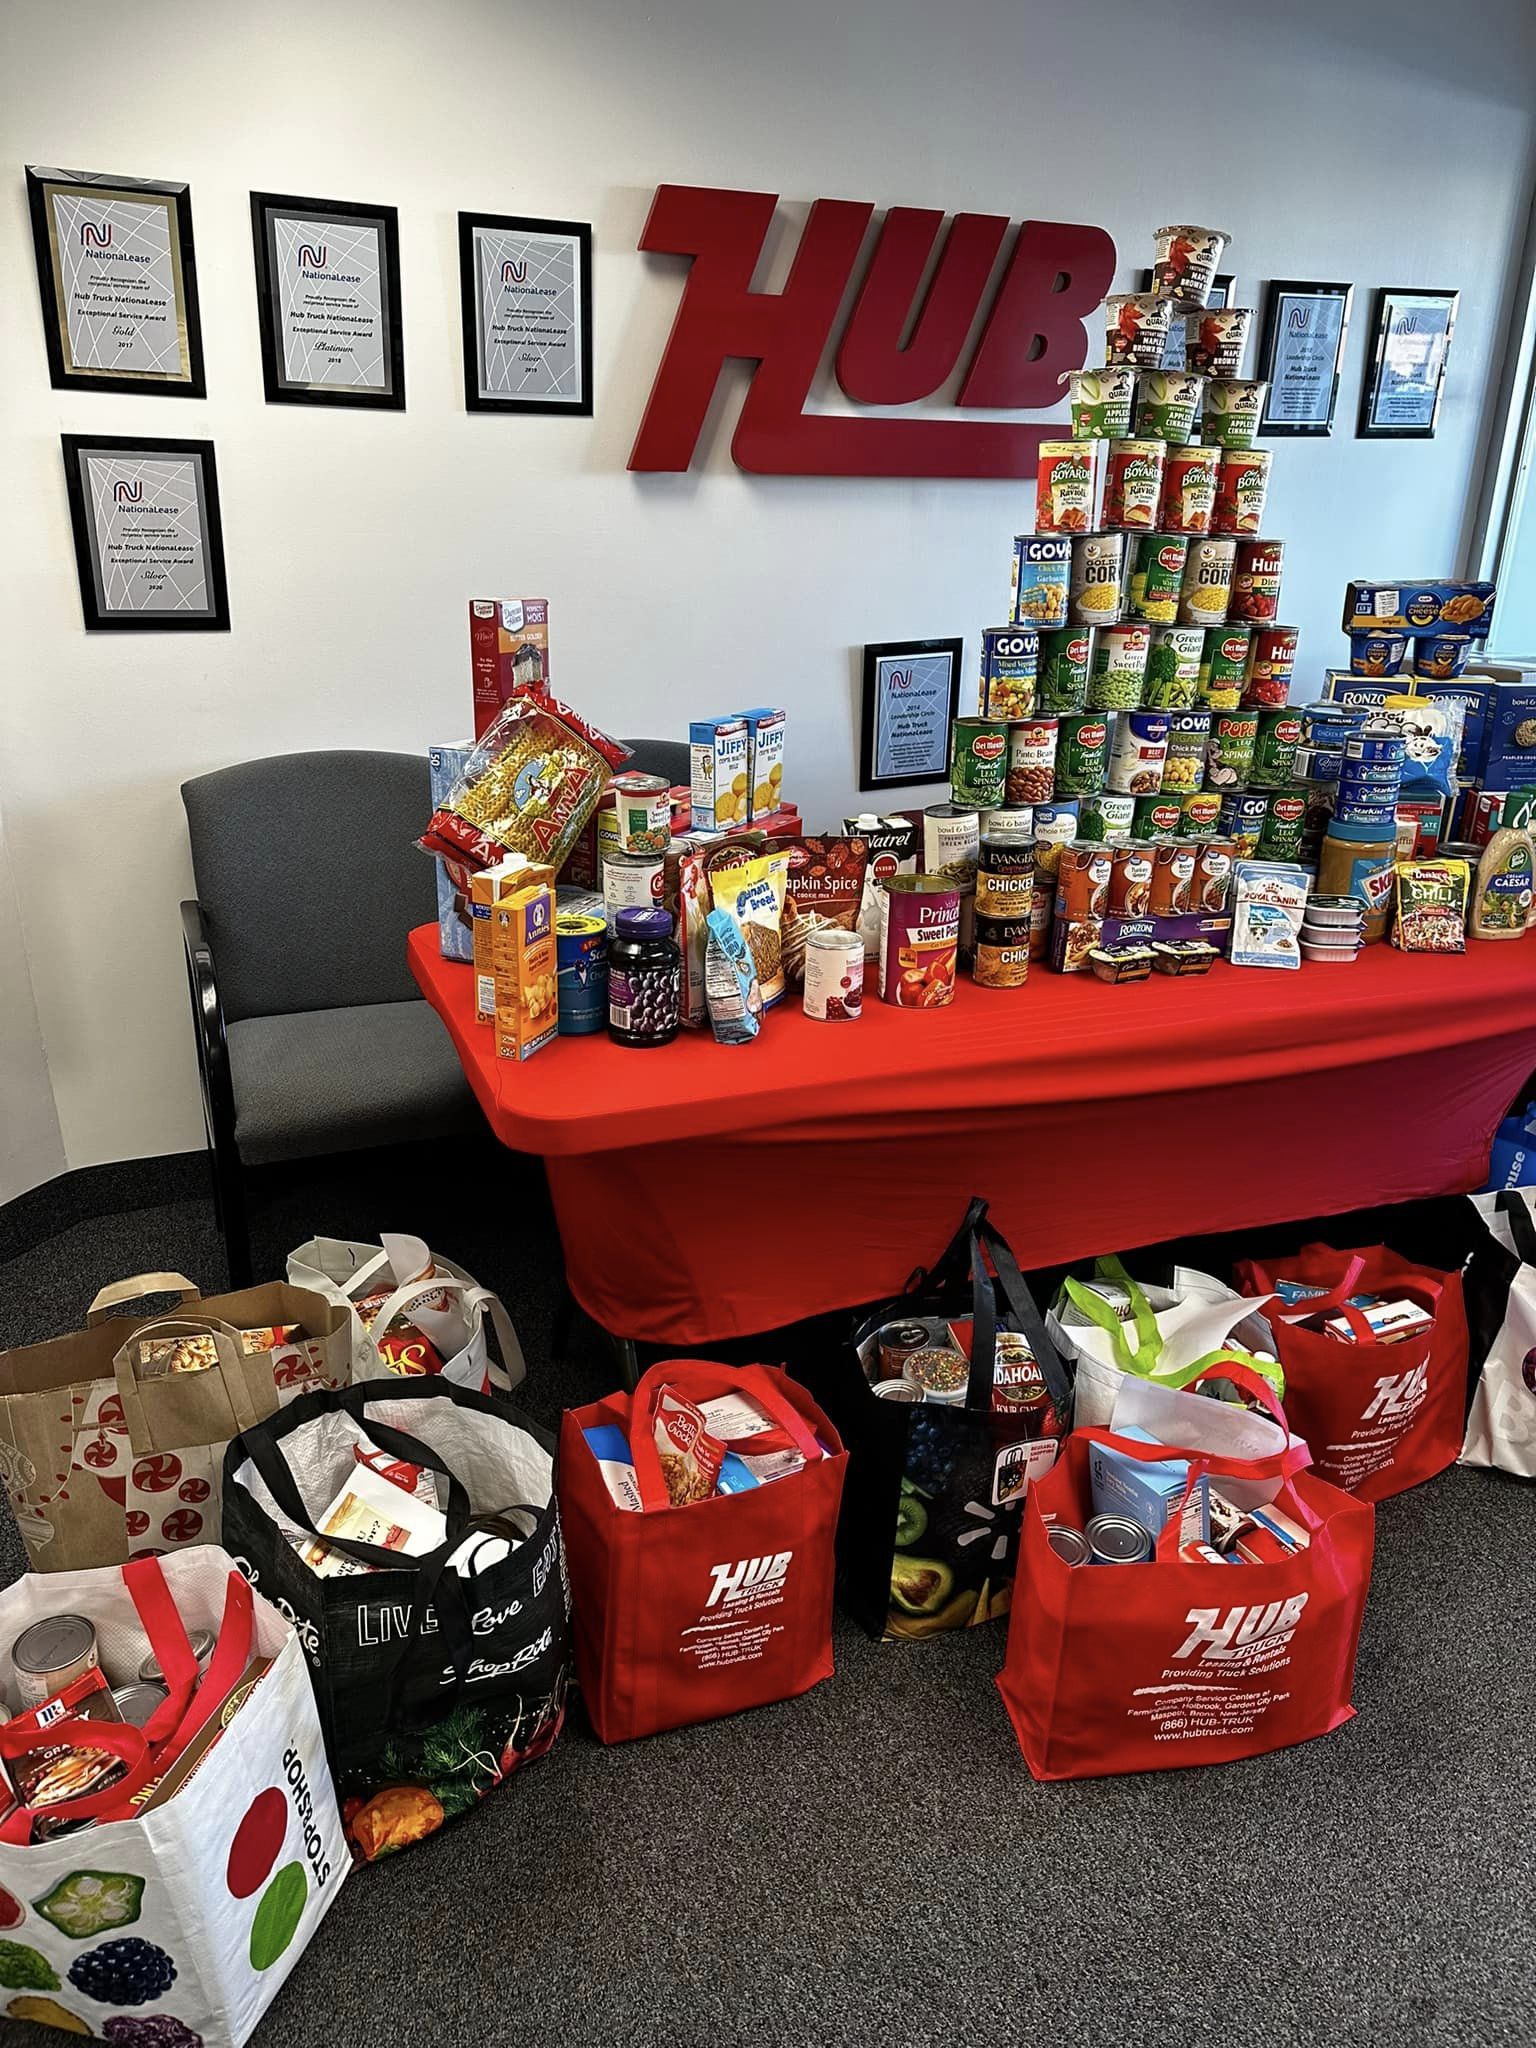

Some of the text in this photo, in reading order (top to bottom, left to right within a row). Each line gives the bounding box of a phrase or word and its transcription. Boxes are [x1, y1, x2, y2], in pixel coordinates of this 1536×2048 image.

[86, 249, 150, 264] NationaLease
[302, 270, 360, 284] NationaLease
[504, 285, 557, 296] NationaLease
[74, 292, 166, 306] Hub Truck NationaLease
[77, 309, 117, 318] Exceptional
[119, 312, 142, 321] Service
[290, 311, 374, 324] Hub Truck NationaLease
[112, 325, 138, 337] Gold
[293, 326, 328, 335] Exceptional
[525, 327, 567, 335] NationaLease
[626, 183, 1118, 480] HUB
[313, 341, 354, 353] Platinum
[518, 353, 542, 362] Silver
[118, 505, 179, 514] NationaLease
[1029, 543, 1072, 560] GOYA
[141, 571, 168, 580] Silver
[527, 612, 545, 622] MOIST
[997, 636, 1039, 655] GOYA
[891, 689, 937, 699] NationaLease
[1343, 692, 1386, 705] RONZO
[1171, 716, 1210, 732] GOYA
[759, 729, 785, 748] JIFFY
[1081, 731, 1091, 739] Del
[718, 739, 747, 756] JIFFY
[975, 741, 985, 750] Del
[1016, 750, 1034, 758] Pinto
[1104, 801, 1132, 811] Green
[1105, 810, 1130, 820] Giant
[868, 830, 911, 848] Natrel
[825, 875, 858, 889] Spice
[1495, 878, 1529, 887] CAESAR
[1244, 891, 1298, 905] ROYAL CANIN
[1412, 885, 1451, 900] CHILI
[751, 891, 775, 911] Bread
[917, 927, 945, 942] Sweet
[1119, 923, 1153, 936] RONZONI
[705, 1551, 792, 1607] HUB
[741, 1580, 781, 1596] TRUCK
[699, 1597, 783, 1623] Providing Truck Solutions
[471, 1600, 523, 1636] Love
[1171, 1592, 1309, 1660] HUB
[1231, 1633, 1290, 1658] TRUCK
[1198, 1646, 1287, 1668] Leasing & Rentals
[1162, 1656, 1291, 1679] Providing Truck Solutions
[1155, 1695, 1193, 1707] Company
[1196, 1694, 1230, 1702] Service
[1231, 1691, 1261, 1700] Centers
[1225, 1701, 1255, 1709] Garden
[1257, 1698, 1271, 1706] City
[1273, 1692, 1290, 1702] Park
[1240, 1706, 1267, 1715] Jersey
[1160, 1716, 1255, 1731] (866) HUB-TRUK
[1153, 1726, 1254, 1741] www.hubtruck.com
